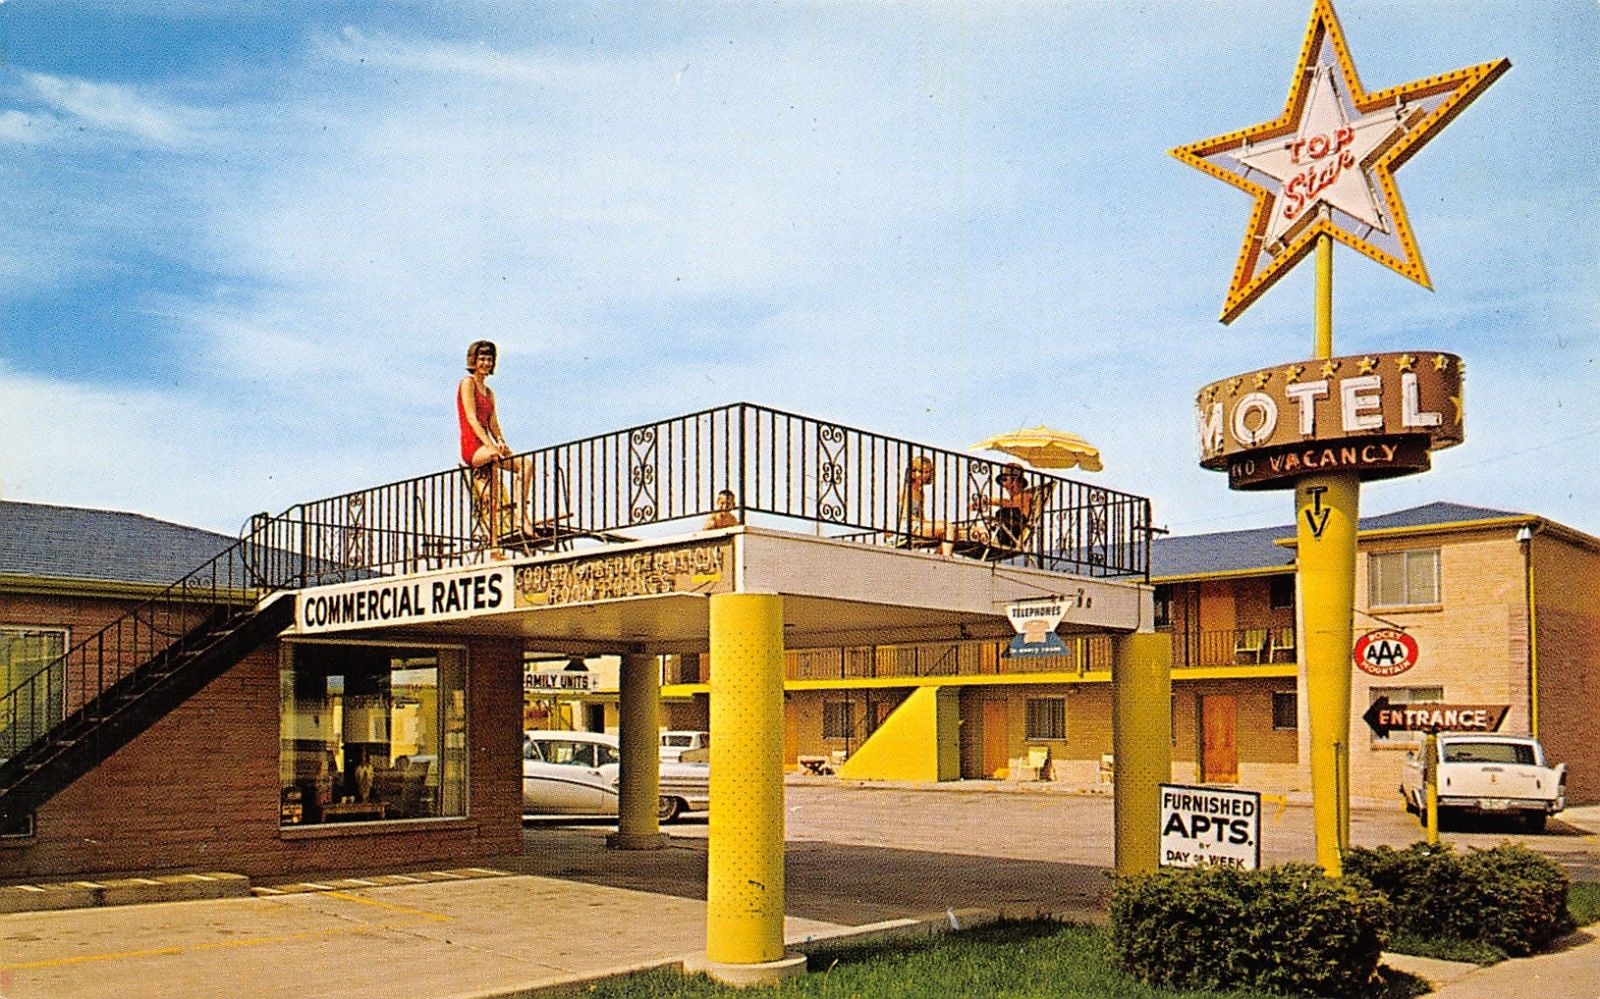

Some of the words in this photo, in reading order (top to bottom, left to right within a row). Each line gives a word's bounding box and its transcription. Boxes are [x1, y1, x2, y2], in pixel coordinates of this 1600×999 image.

[1284, 127, 1355, 164] TOP
[1283, 150, 1355, 219] Star
[1195, 372, 1442, 453] MOTEL
[1269, 444, 1398, 472] VACANCY
[305, 585, 425, 627] COMMERCIAL
[432, 573, 503, 614] RATES
[1012, 606, 1062, 618] TELEPHONES
[1367, 641, 1404, 665] AAA
[1361, 660, 1411, 675] MOUNTAIN
[524, 673, 557, 688] AMILY
[560, 675, 589, 688] UNITS
[1380, 710, 1486, 726] ENTRANCE
[1164, 793, 1254, 817] FURNISHED
[1163, 813, 1254, 846] APTS.
[1166, 850, 1190, 863] DAY
